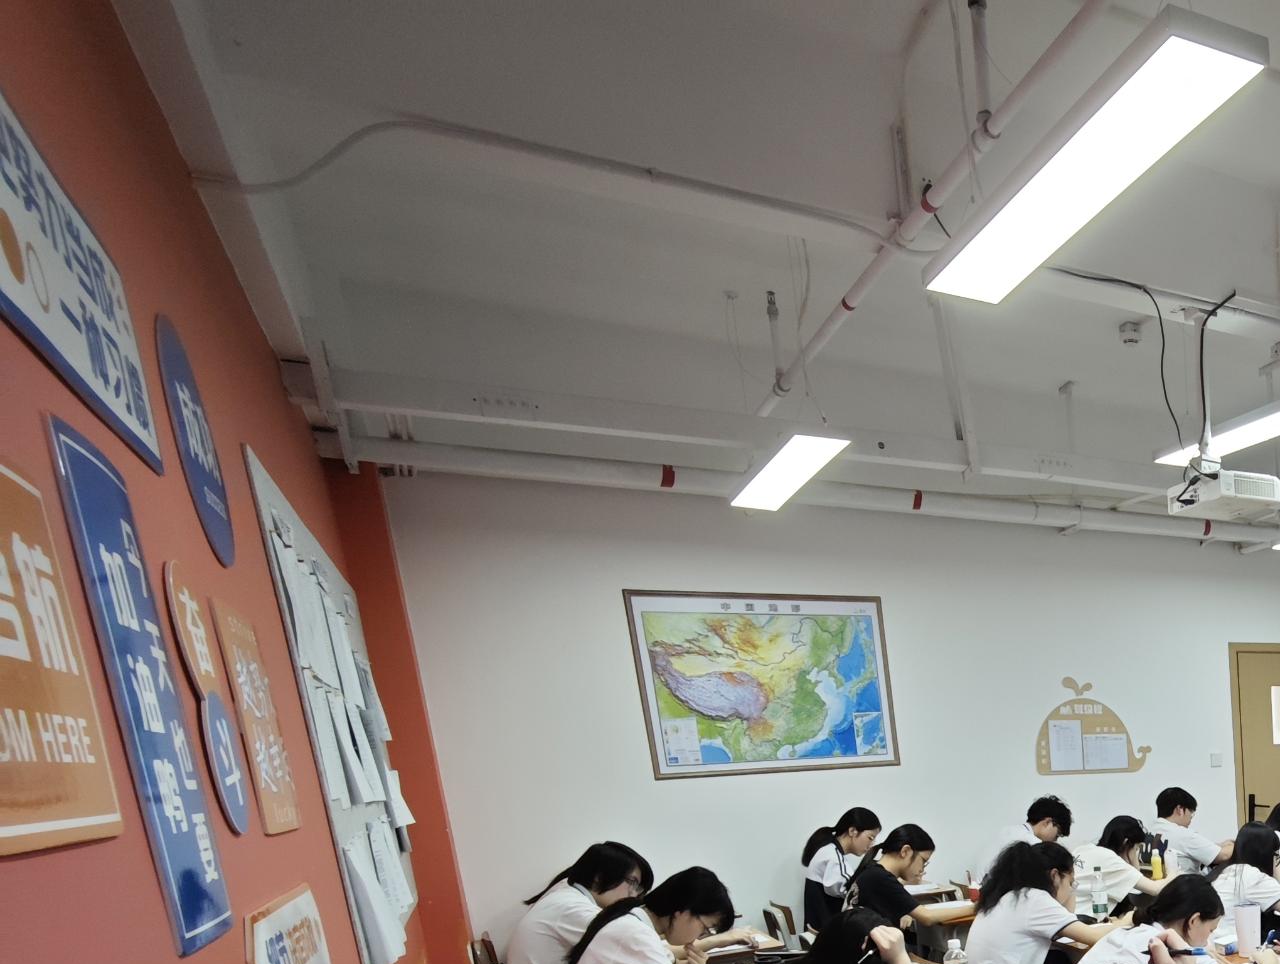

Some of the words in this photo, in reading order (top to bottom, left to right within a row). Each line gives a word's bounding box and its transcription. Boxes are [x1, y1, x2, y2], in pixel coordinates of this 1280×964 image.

[0, 113, 121, 334] 努力当成
[36, 711, 97, 764] HERE
[99, 541, 189, 835] 加油鸭
